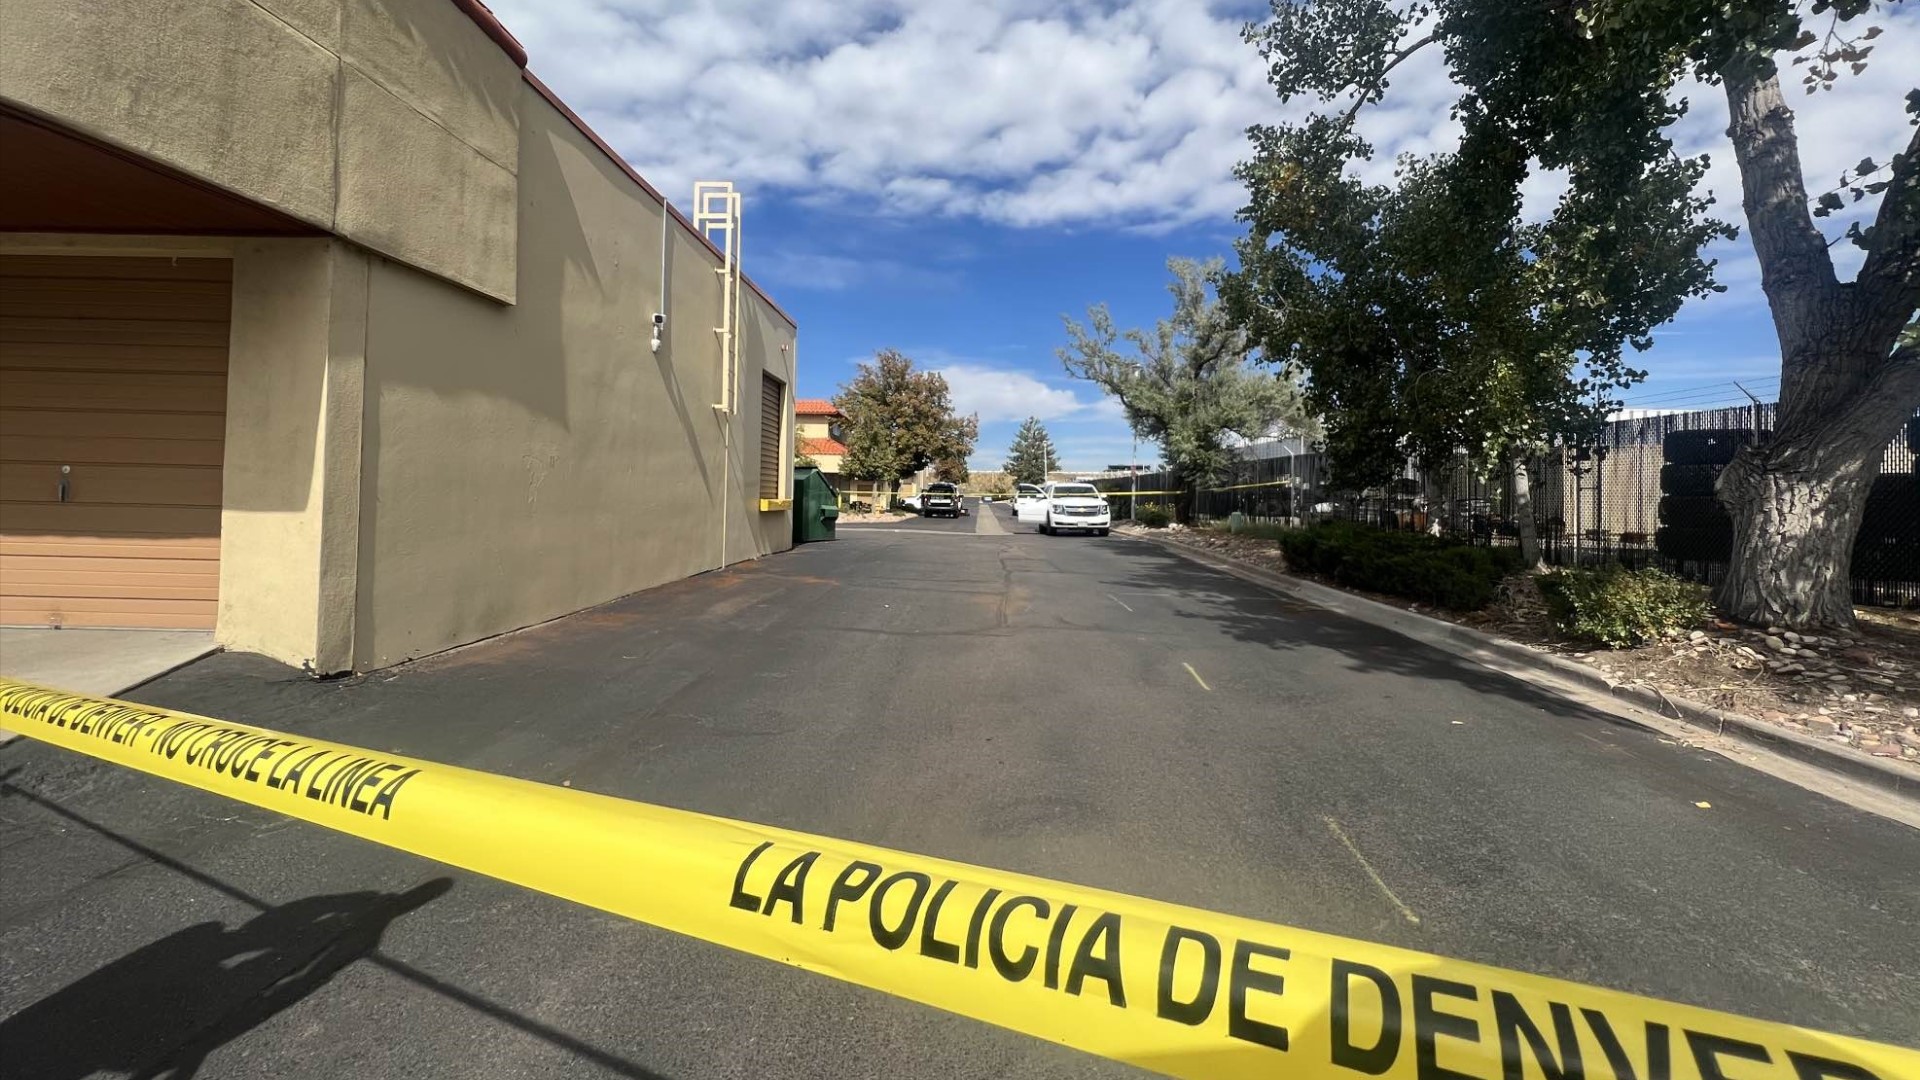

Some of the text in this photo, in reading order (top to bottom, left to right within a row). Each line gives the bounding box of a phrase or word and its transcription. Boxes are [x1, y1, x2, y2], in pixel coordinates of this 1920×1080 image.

[47, 697, 102, 728] DE
[69, 703, 171, 747] DENVER
[150, 720, 216, 760] NO
[186, 728, 299, 783] CRUCE
[266, 745, 333, 795] LA
[305, 754, 424, 821] LINEA
[729, 841, 1884, 1080] LA POLICIA DE DENV
